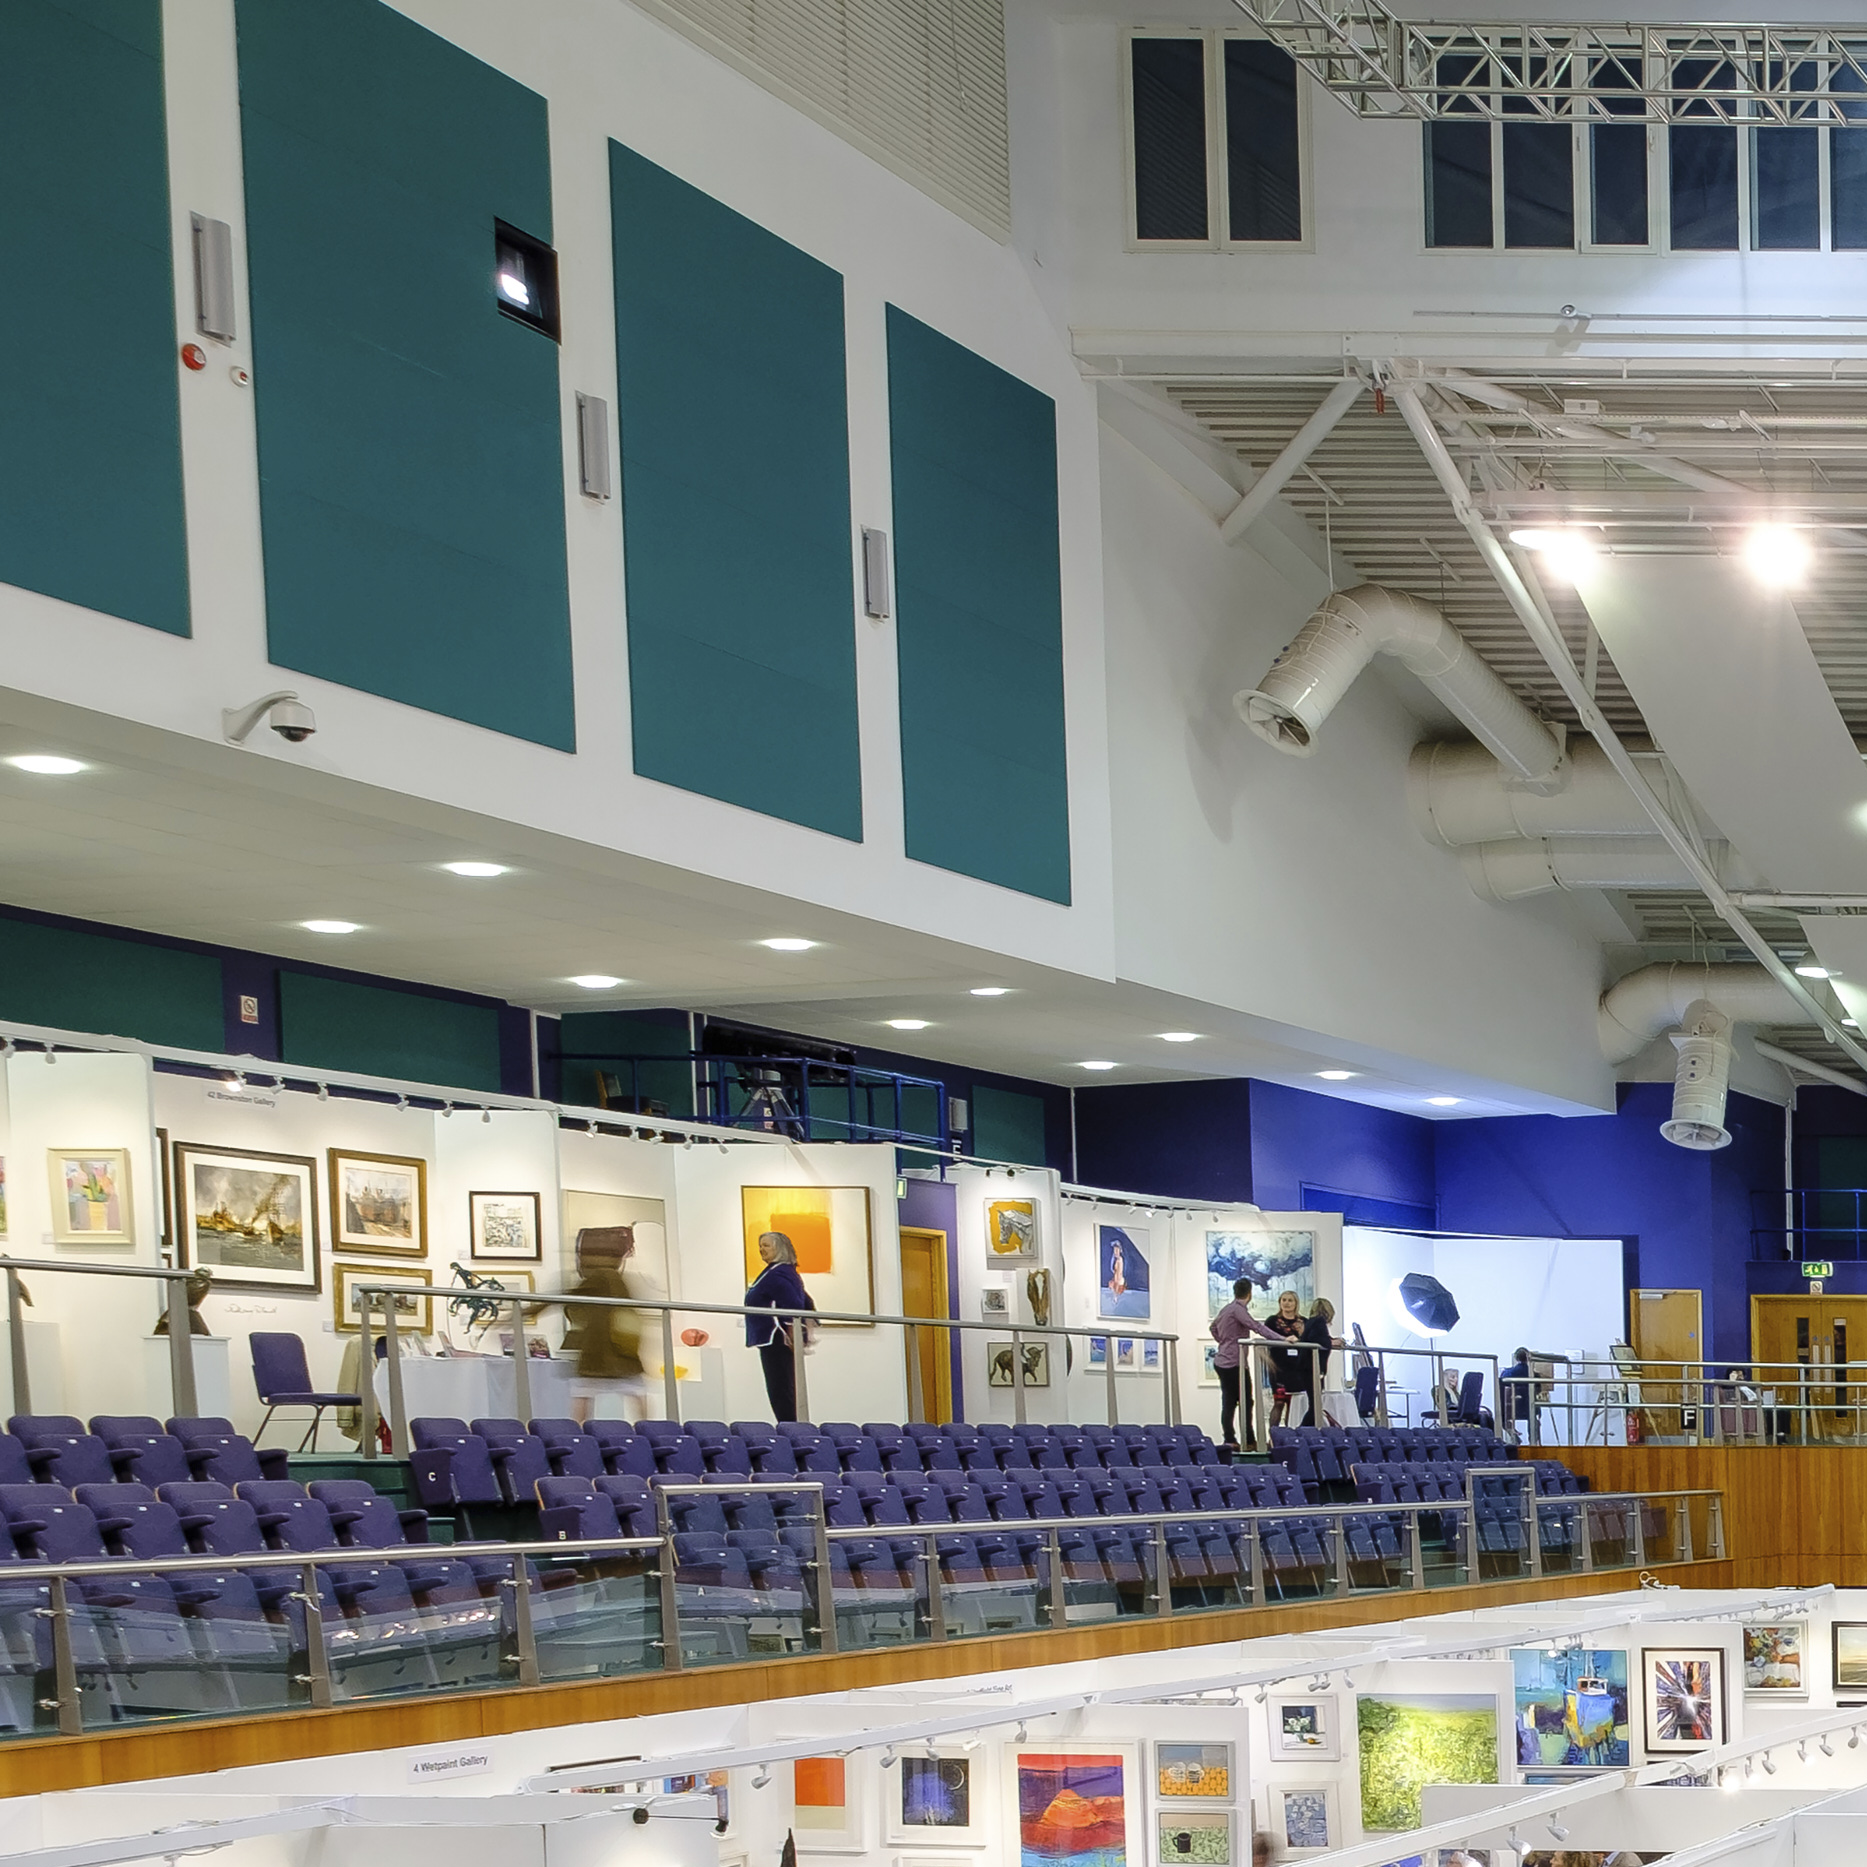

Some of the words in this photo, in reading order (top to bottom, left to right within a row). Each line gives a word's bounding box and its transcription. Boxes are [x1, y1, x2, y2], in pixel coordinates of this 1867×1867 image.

[1684, 1409, 1695, 1426] F
[428, 1471, 437, 1482] C
[558, 1530, 566, 1540] B
[698, 1586, 705, 1597] A
[413, 1763, 420, 1773] 4
[420, 1758, 459, 1773] Wetpaint
[460, 1755, 488, 1768] Gallery
